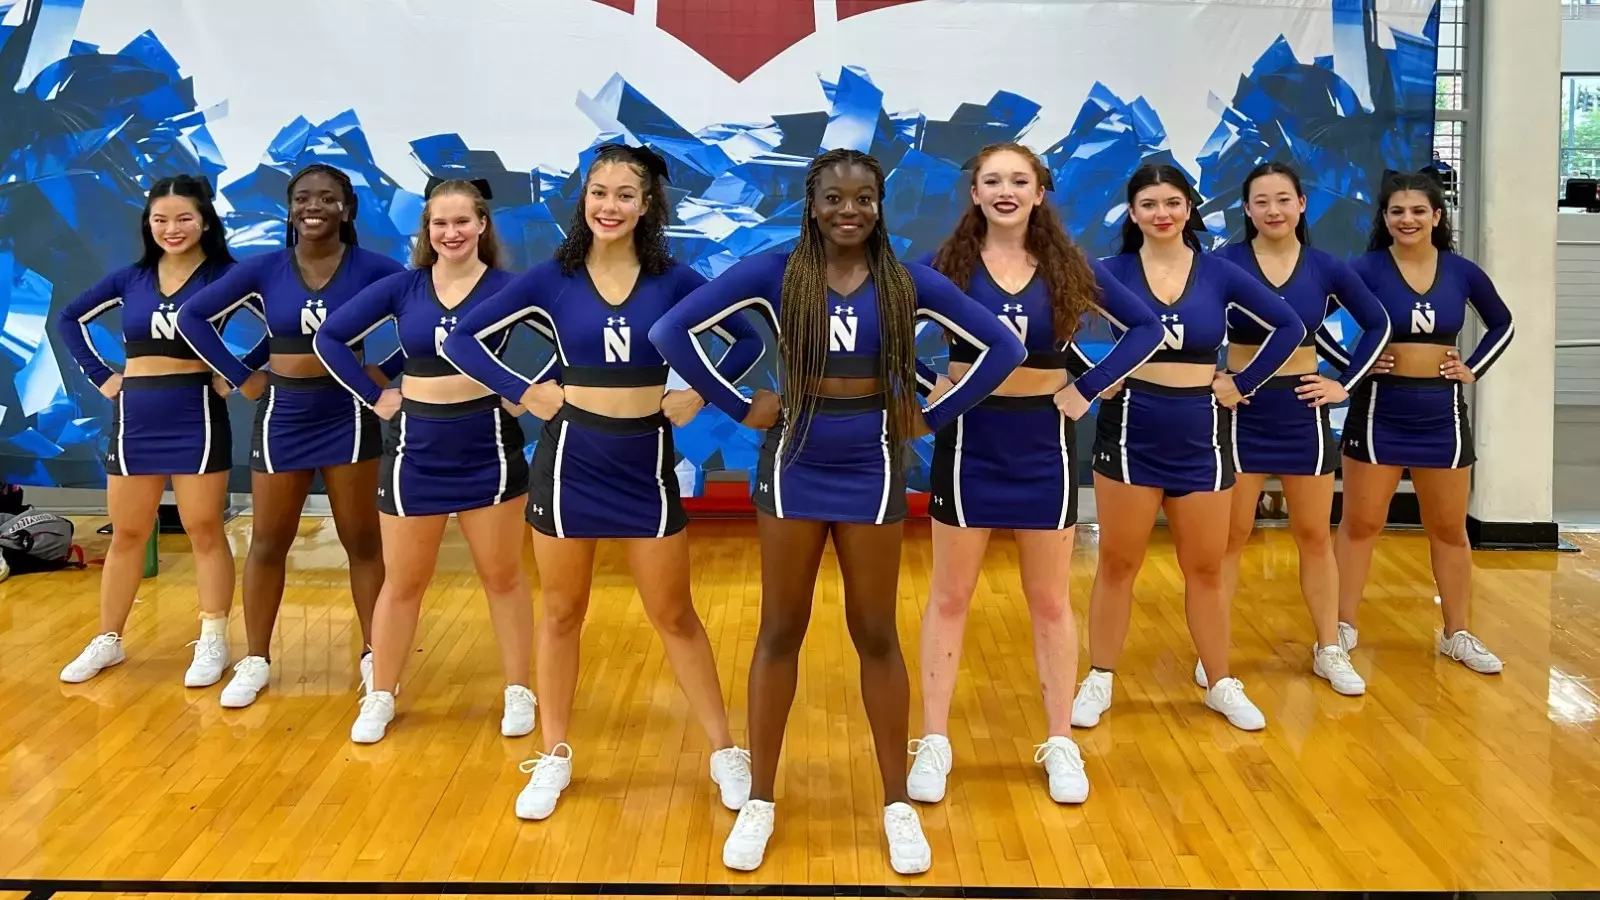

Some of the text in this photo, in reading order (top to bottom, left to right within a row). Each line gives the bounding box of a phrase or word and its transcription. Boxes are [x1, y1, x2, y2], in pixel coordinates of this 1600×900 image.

[151, 311, 176, 339] N
[301, 307, 327, 335] N
[830, 316, 859, 351] N
[1411, 309, 1435, 334] N
[604, 326, 630, 362] N
[1160, 323, 1184, 351] N
